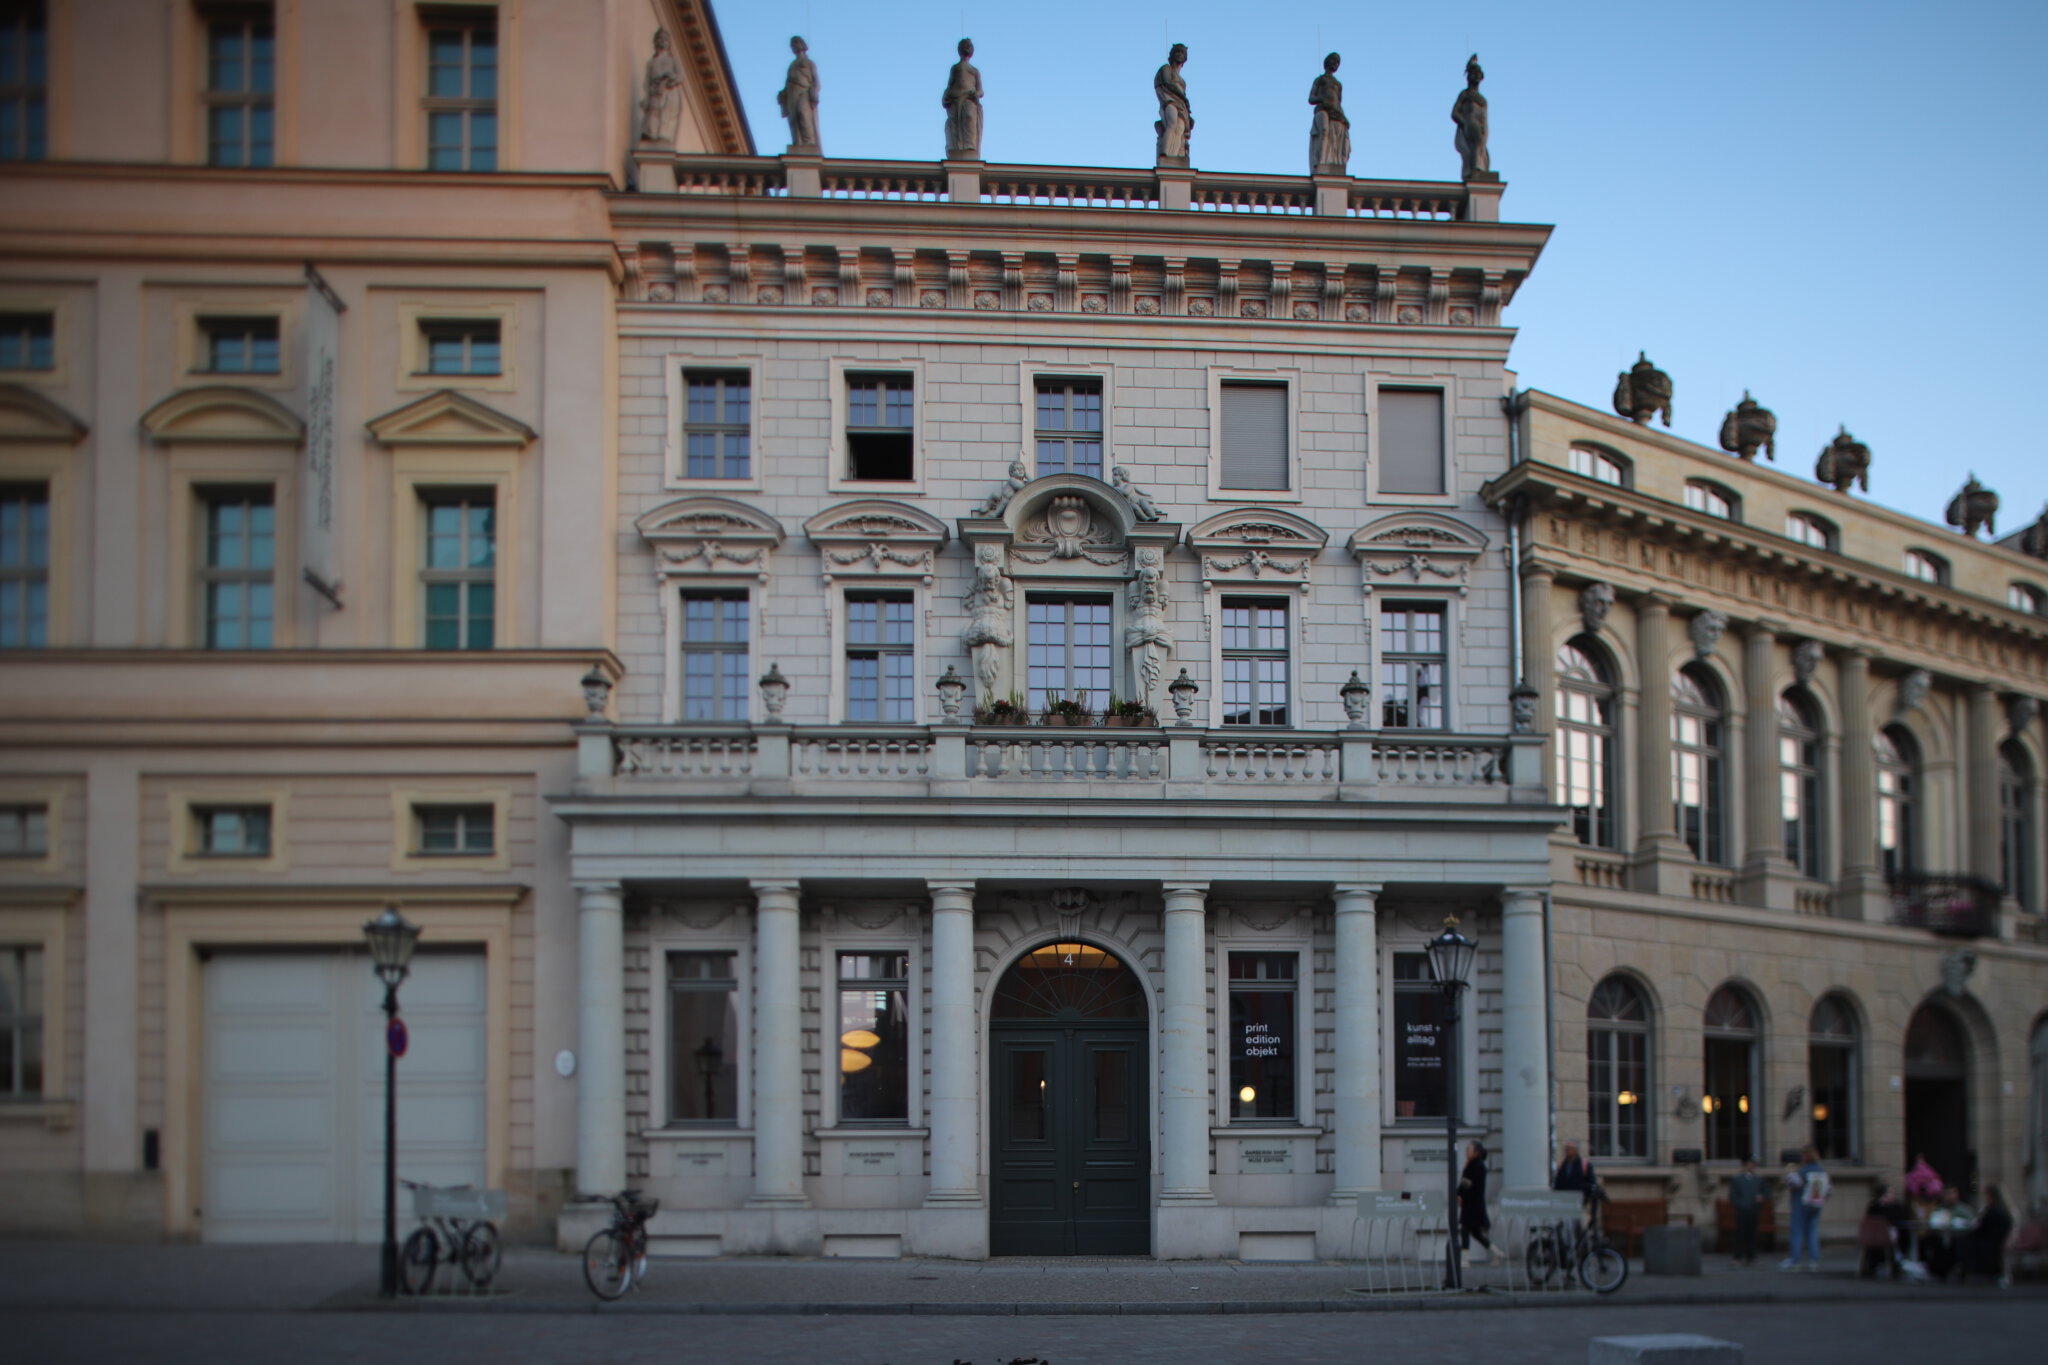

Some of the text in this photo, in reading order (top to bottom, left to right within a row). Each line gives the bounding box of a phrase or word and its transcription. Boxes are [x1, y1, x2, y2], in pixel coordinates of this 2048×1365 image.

[1063, 952, 1074, 966] 4
[1245, 1022, 1269, 1034] print
[1407, 1022, 1433, 1032] kunst
[1245, 1034, 1281, 1044] edition
[1407, 1033, 1436, 1047] alltag
[1245, 1046, 1278, 1058] objekt
